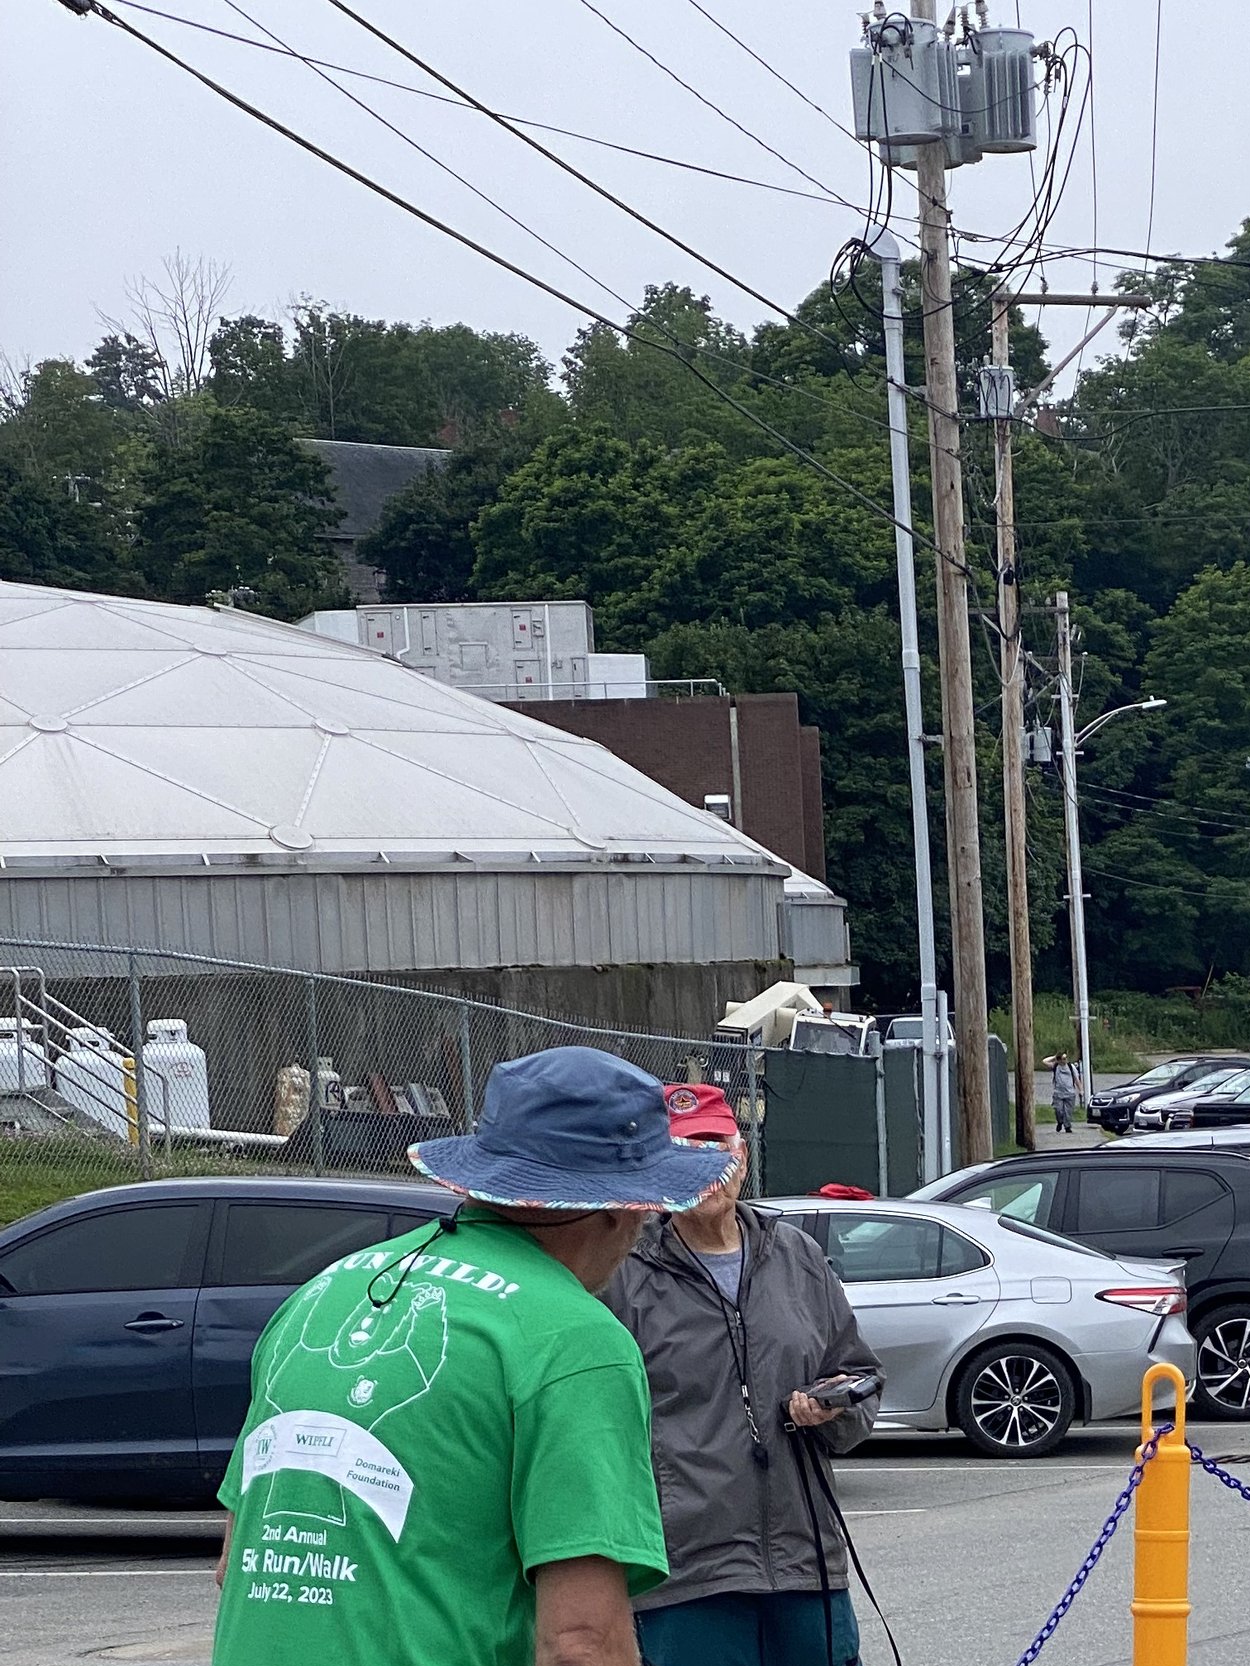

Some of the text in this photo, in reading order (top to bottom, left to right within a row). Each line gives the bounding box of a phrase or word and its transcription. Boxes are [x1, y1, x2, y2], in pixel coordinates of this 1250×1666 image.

[400, 1252, 521, 1300] WILD!
[296, 1433, 335, 1448] WIPFLI
[355, 1457, 401, 1478] Domareki
[346, 1470, 401, 1492] Foundation
[261, 1524, 327, 1546] 2nd Annual
[241, 1548, 359, 1582] 5k Run/Walk
[248, 1582, 333, 1606] July 22, 2023
